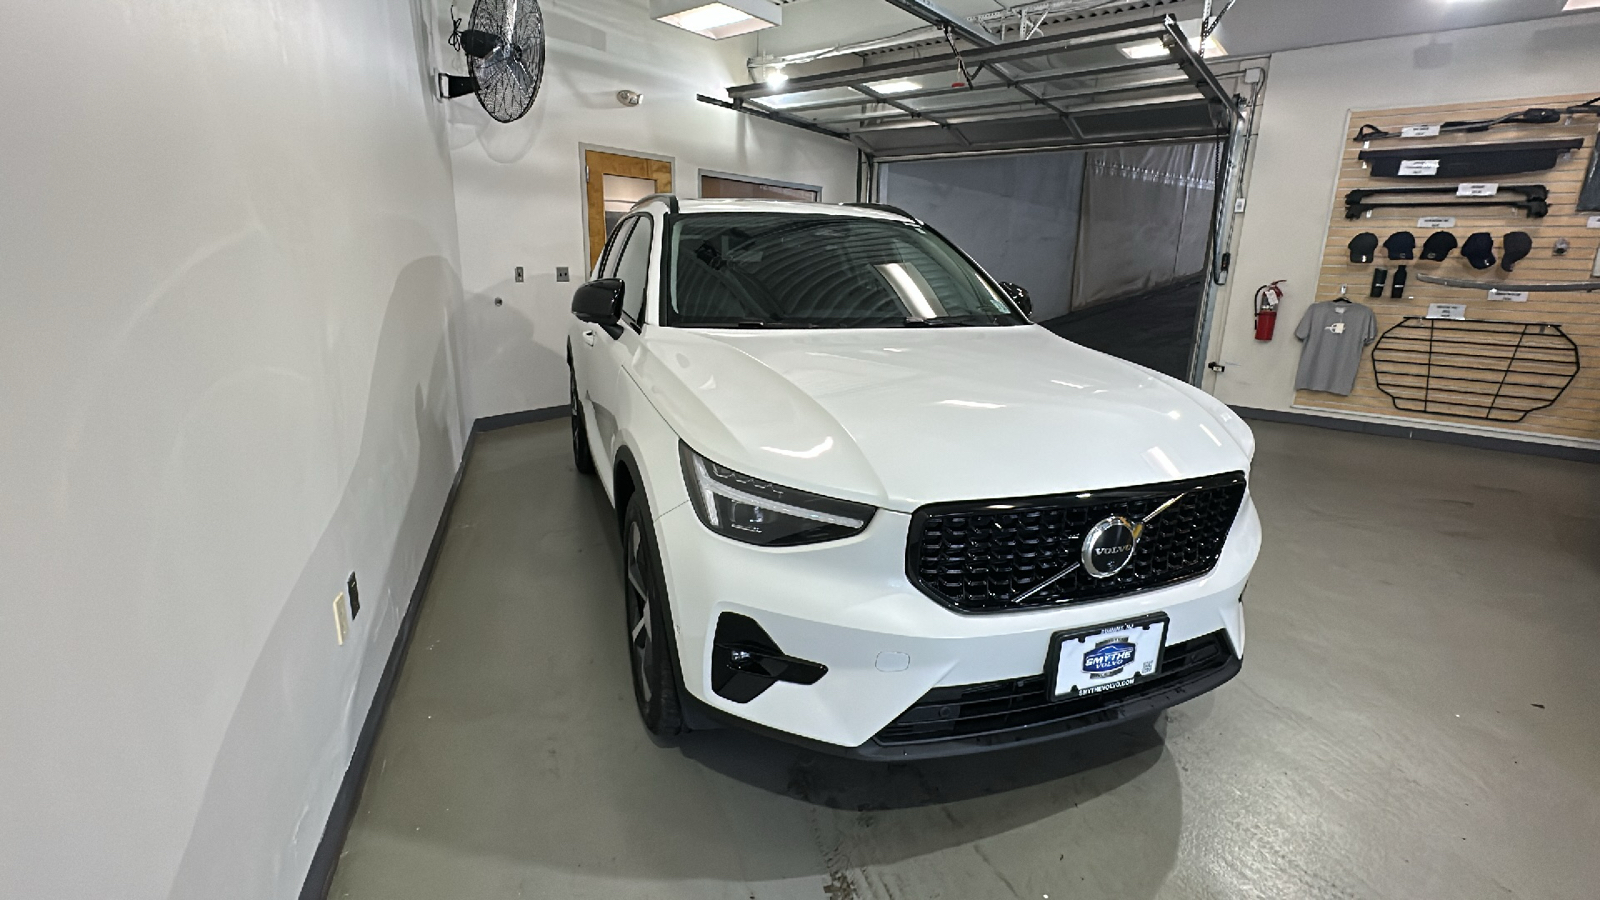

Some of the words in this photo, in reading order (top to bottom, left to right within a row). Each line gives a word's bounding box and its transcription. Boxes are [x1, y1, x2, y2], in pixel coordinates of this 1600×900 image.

[1095, 544, 1132, 555] VOLVO
[1085, 651, 1132, 667] SMYTHE
[1096, 659, 1124, 669] VOLVO
[1078, 678, 1135, 696] SMYTHEVOLVO.COM
